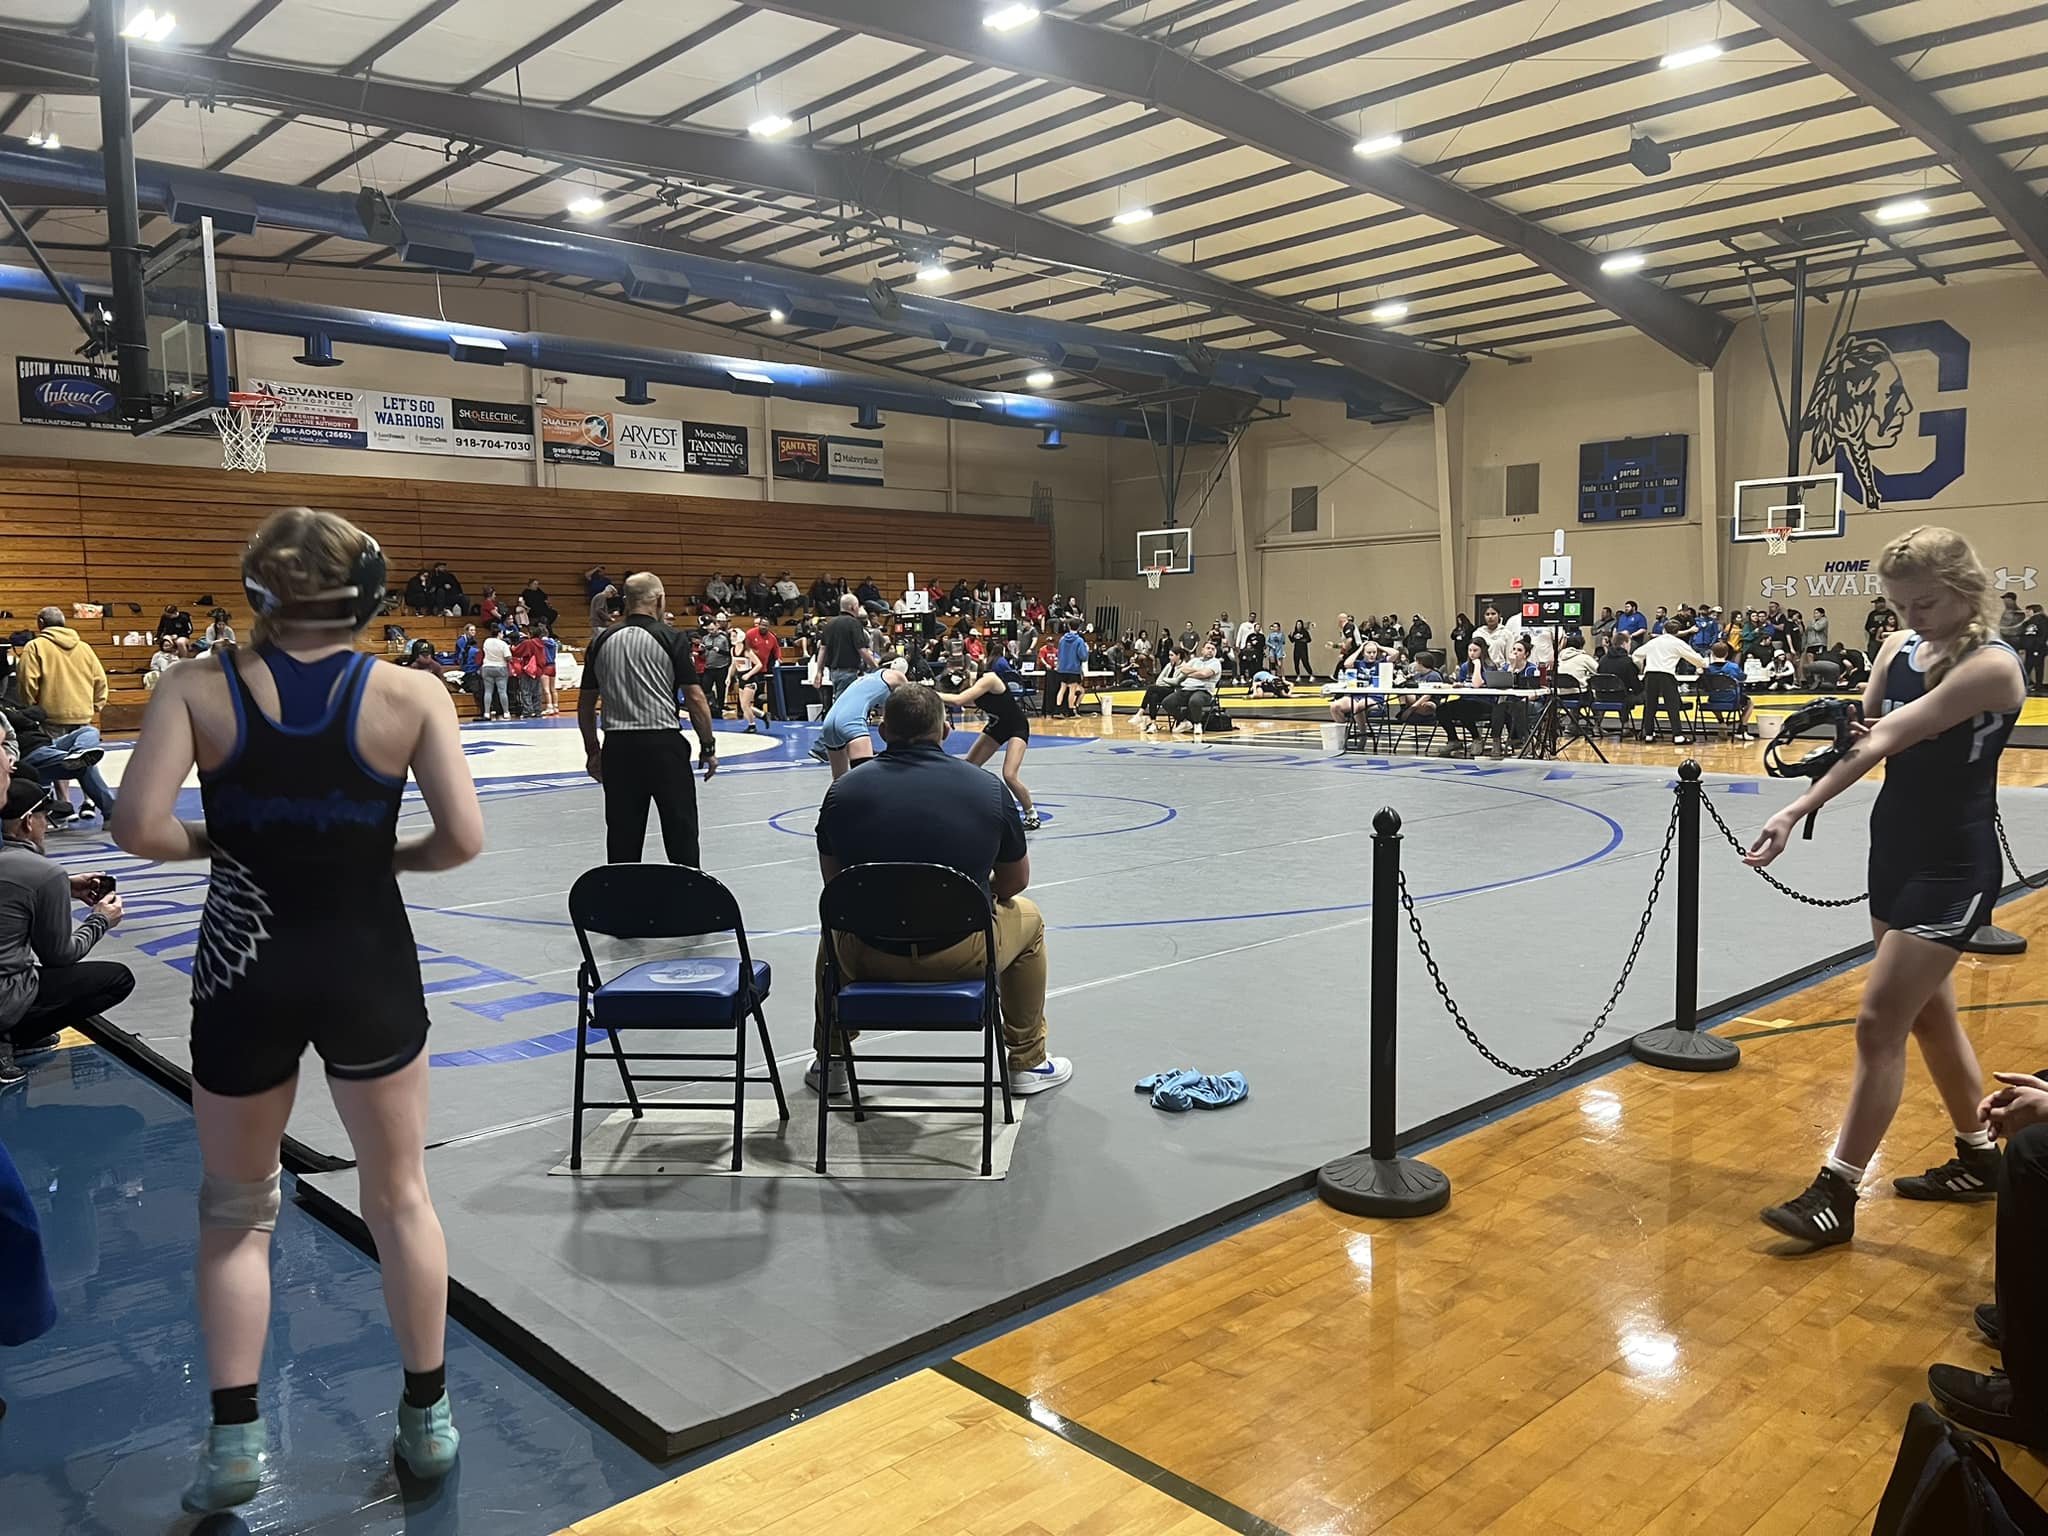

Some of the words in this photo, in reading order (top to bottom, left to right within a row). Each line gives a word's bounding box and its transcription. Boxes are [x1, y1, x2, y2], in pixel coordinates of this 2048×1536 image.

[20, 361, 50, 378] CUSTOM
[54, 363, 90, 377] ATHLETIC
[40, 382, 113, 407] Inkwell
[278, 386, 354, 402] ADVANCED
[383, 396, 418, 412] LET'S
[420, 400, 435, 413] GO
[375, 411, 445, 430] WARRIORS!
[543, 418, 581, 427] QUALITY
[620, 425, 678, 449] ARVEST
[695, 429, 716, 440] Moon
[717, 431, 737, 441] Shine
[455, 437, 531, 451] 918-704-7030
[688, 439, 744, 456] TANNING
[780, 440, 806, 453] SANTA
[807, 443, 817, 456] FE
[630, 449, 667, 461] BANK
[1552, 559, 1558, 576] 1
[1824, 560, 1870, 573] HOME
[1805, 574, 1884, 598] WAR
[914, 593, 921, 604] 2
